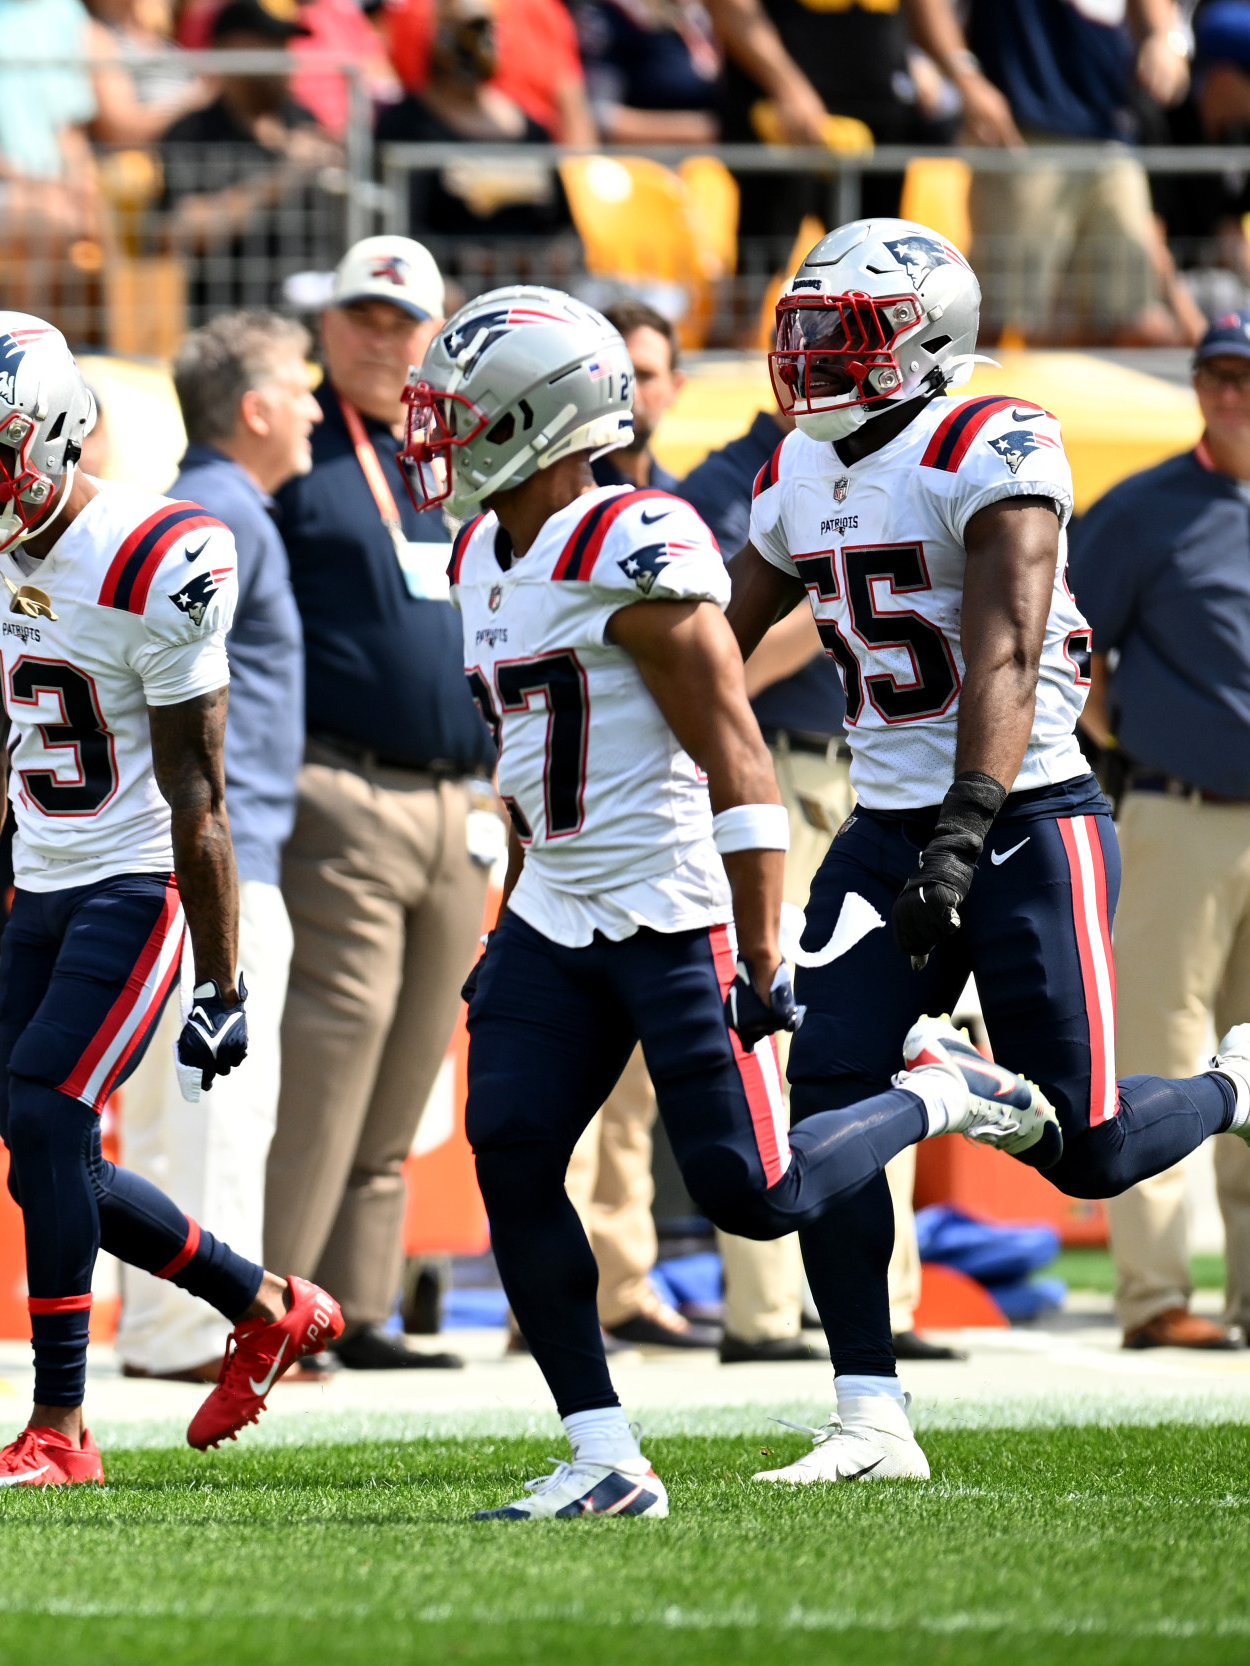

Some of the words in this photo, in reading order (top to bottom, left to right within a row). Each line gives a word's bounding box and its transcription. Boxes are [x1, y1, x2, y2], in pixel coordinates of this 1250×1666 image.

[620, 372, 633, 401] 2
[820, 514, 859, 536] PATRIOTS
[2, 622, 41, 643] PATRIOTS
[475, 628, 508, 646] PATRIOTS
[790, 541, 962, 726] 55
